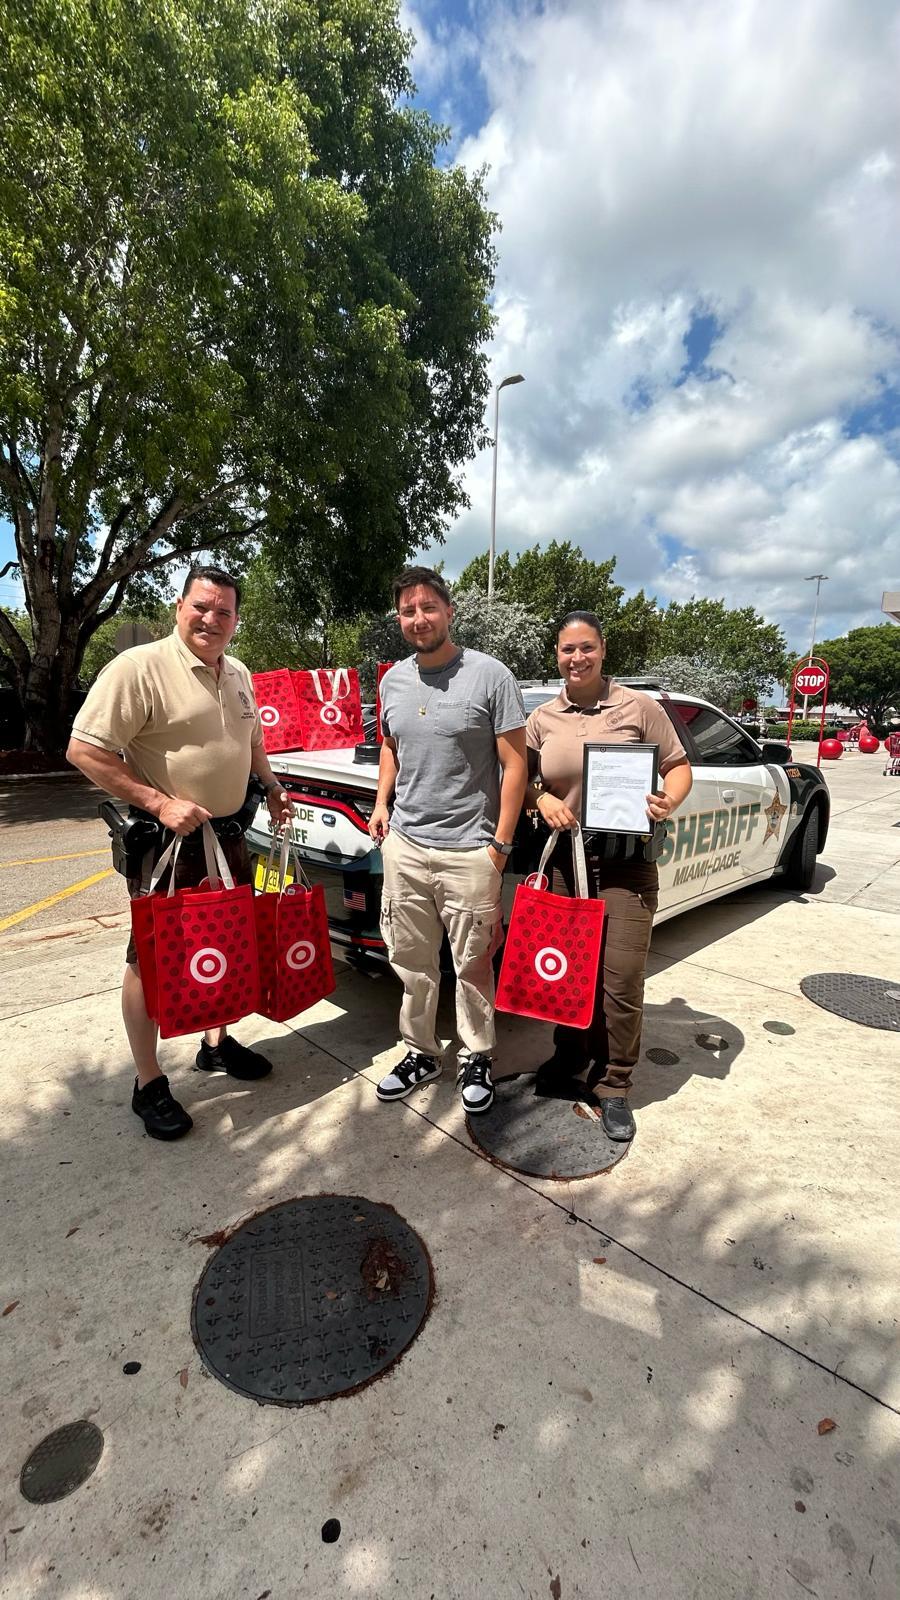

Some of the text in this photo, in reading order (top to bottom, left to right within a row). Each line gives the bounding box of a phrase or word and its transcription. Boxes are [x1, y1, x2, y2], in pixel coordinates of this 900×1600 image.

[797, 675, 825, 687] STOP
[656, 801, 762, 867] SHERIFF
[672, 850, 742, 888] MIAMI-DADE
